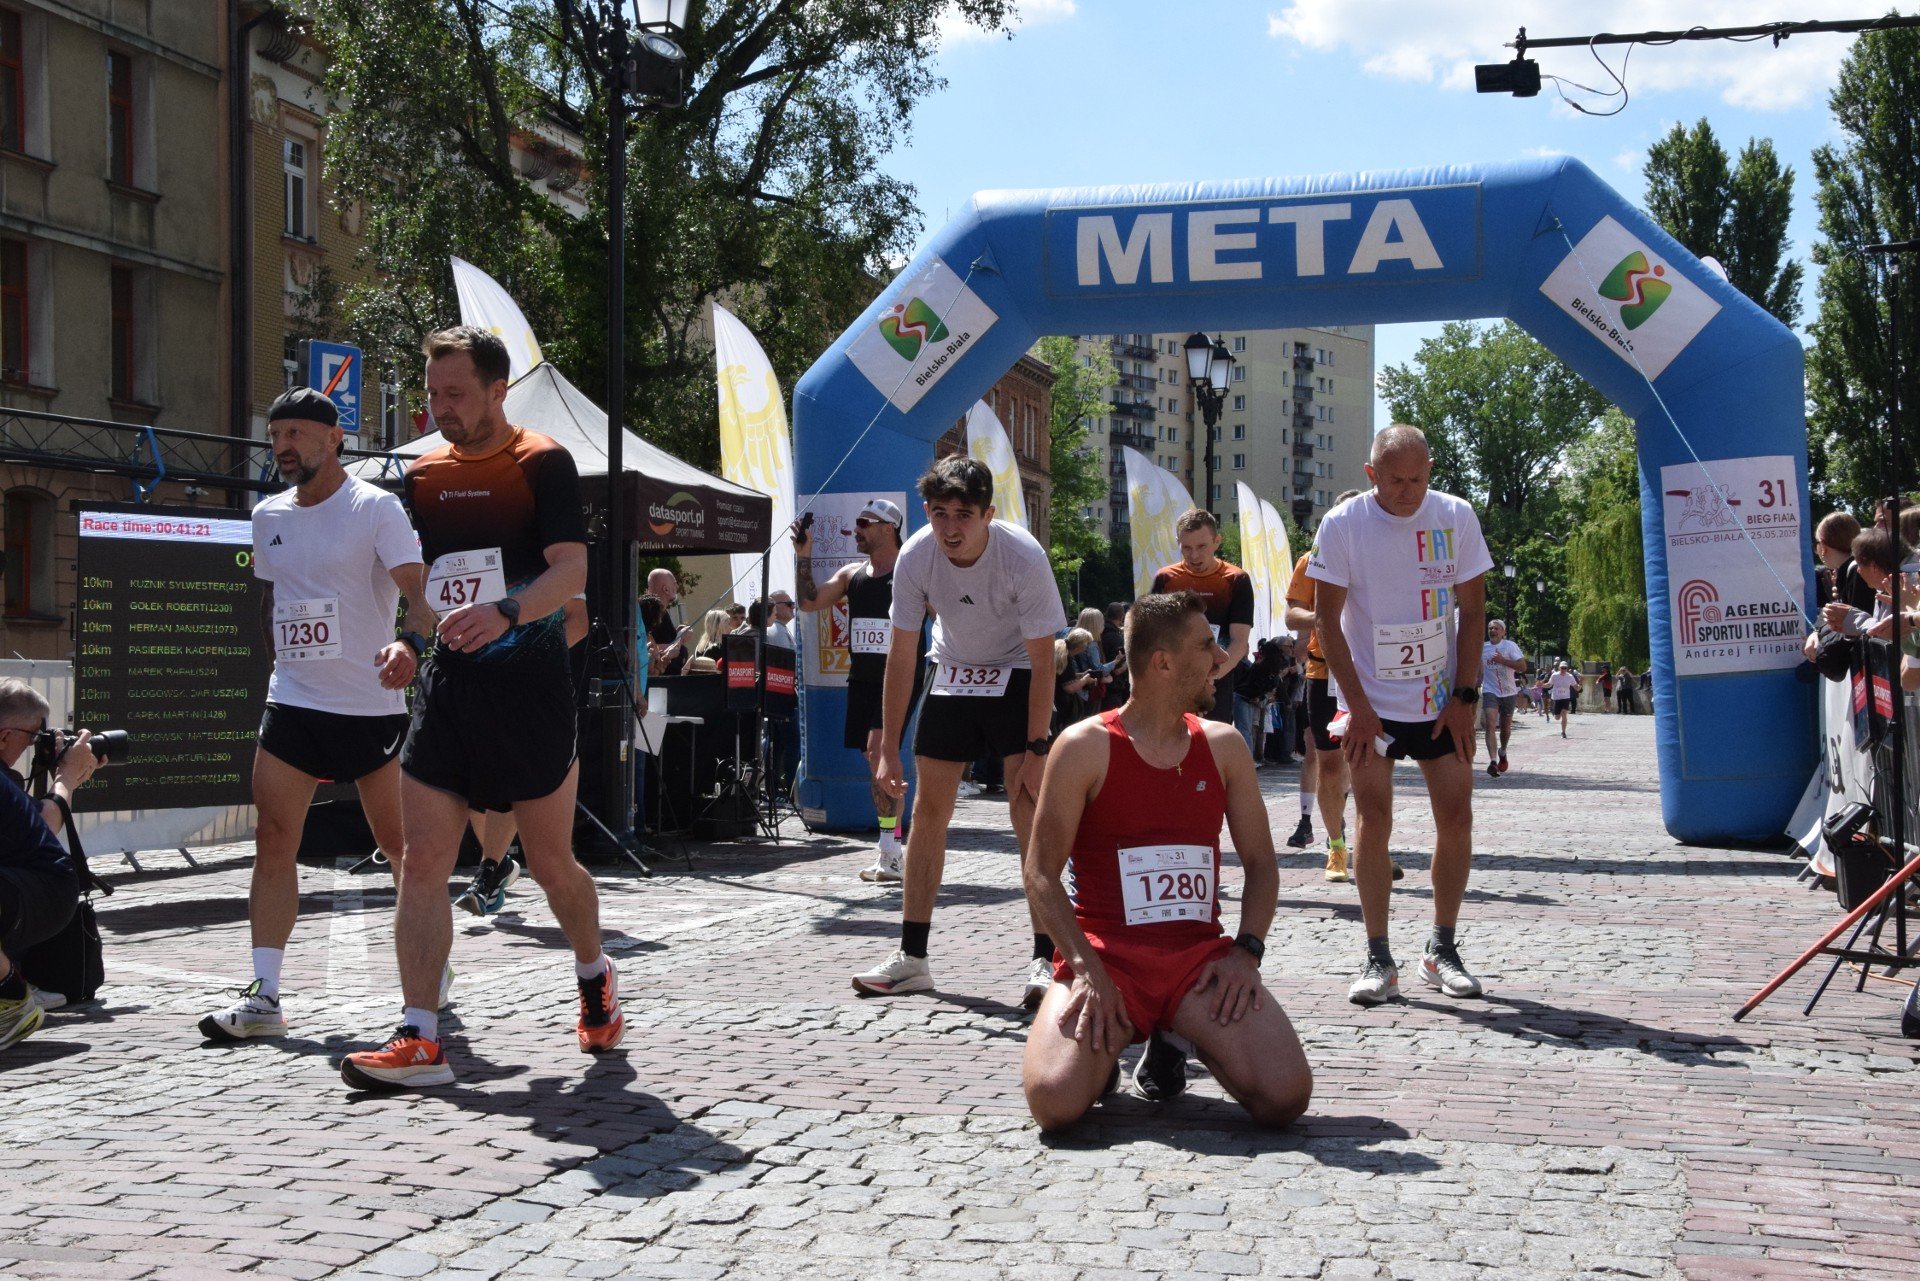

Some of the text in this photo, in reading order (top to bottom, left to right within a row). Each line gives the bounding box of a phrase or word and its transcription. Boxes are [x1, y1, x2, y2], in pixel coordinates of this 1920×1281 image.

[1076, 199, 1444, 286] META
[1571, 298, 1634, 353] Bielsko-Biała
[915, 332, 971, 386] Bielsko-Biała
[467, 490, 491, 498] Systems
[649, 502, 704, 527] datasport.pl
[1747, 512, 1797, 525] BIEG FIATA
[83, 518, 211, 537] Race time:00:41:21
[1416, 528, 1454, 562] FIAT
[1671, 532, 1745, 547] BIELSKO-BIAŁA
[83, 576, 113, 589] 10km
[440, 577, 482, 606] 437
[82, 600, 113, 611] 10km
[1725, 601, 1799, 618] AGENCJA
[82, 622, 112, 633] 10km
[281, 622, 329, 646] 1230
[1698, 619, 1801, 643] SPORTU I REKLAMY
[855, 630, 885, 644] 1103
[81, 644, 112, 656] 10km
[1400, 643, 1425, 665] 21
[1685, 641, 1801, 659] Andrzej Filipiak
[81, 666, 111, 678] 10km
[728, 667, 755, 677] DATASPORT
[767, 672, 794, 685] DATASPORT
[949, 666, 1001, 685] 1332
[80, 688, 111, 700] 10km
[79, 711, 110, 723] 10km
[1174, 851, 1186, 861] 31
[1139, 872, 1207, 902] 1280
